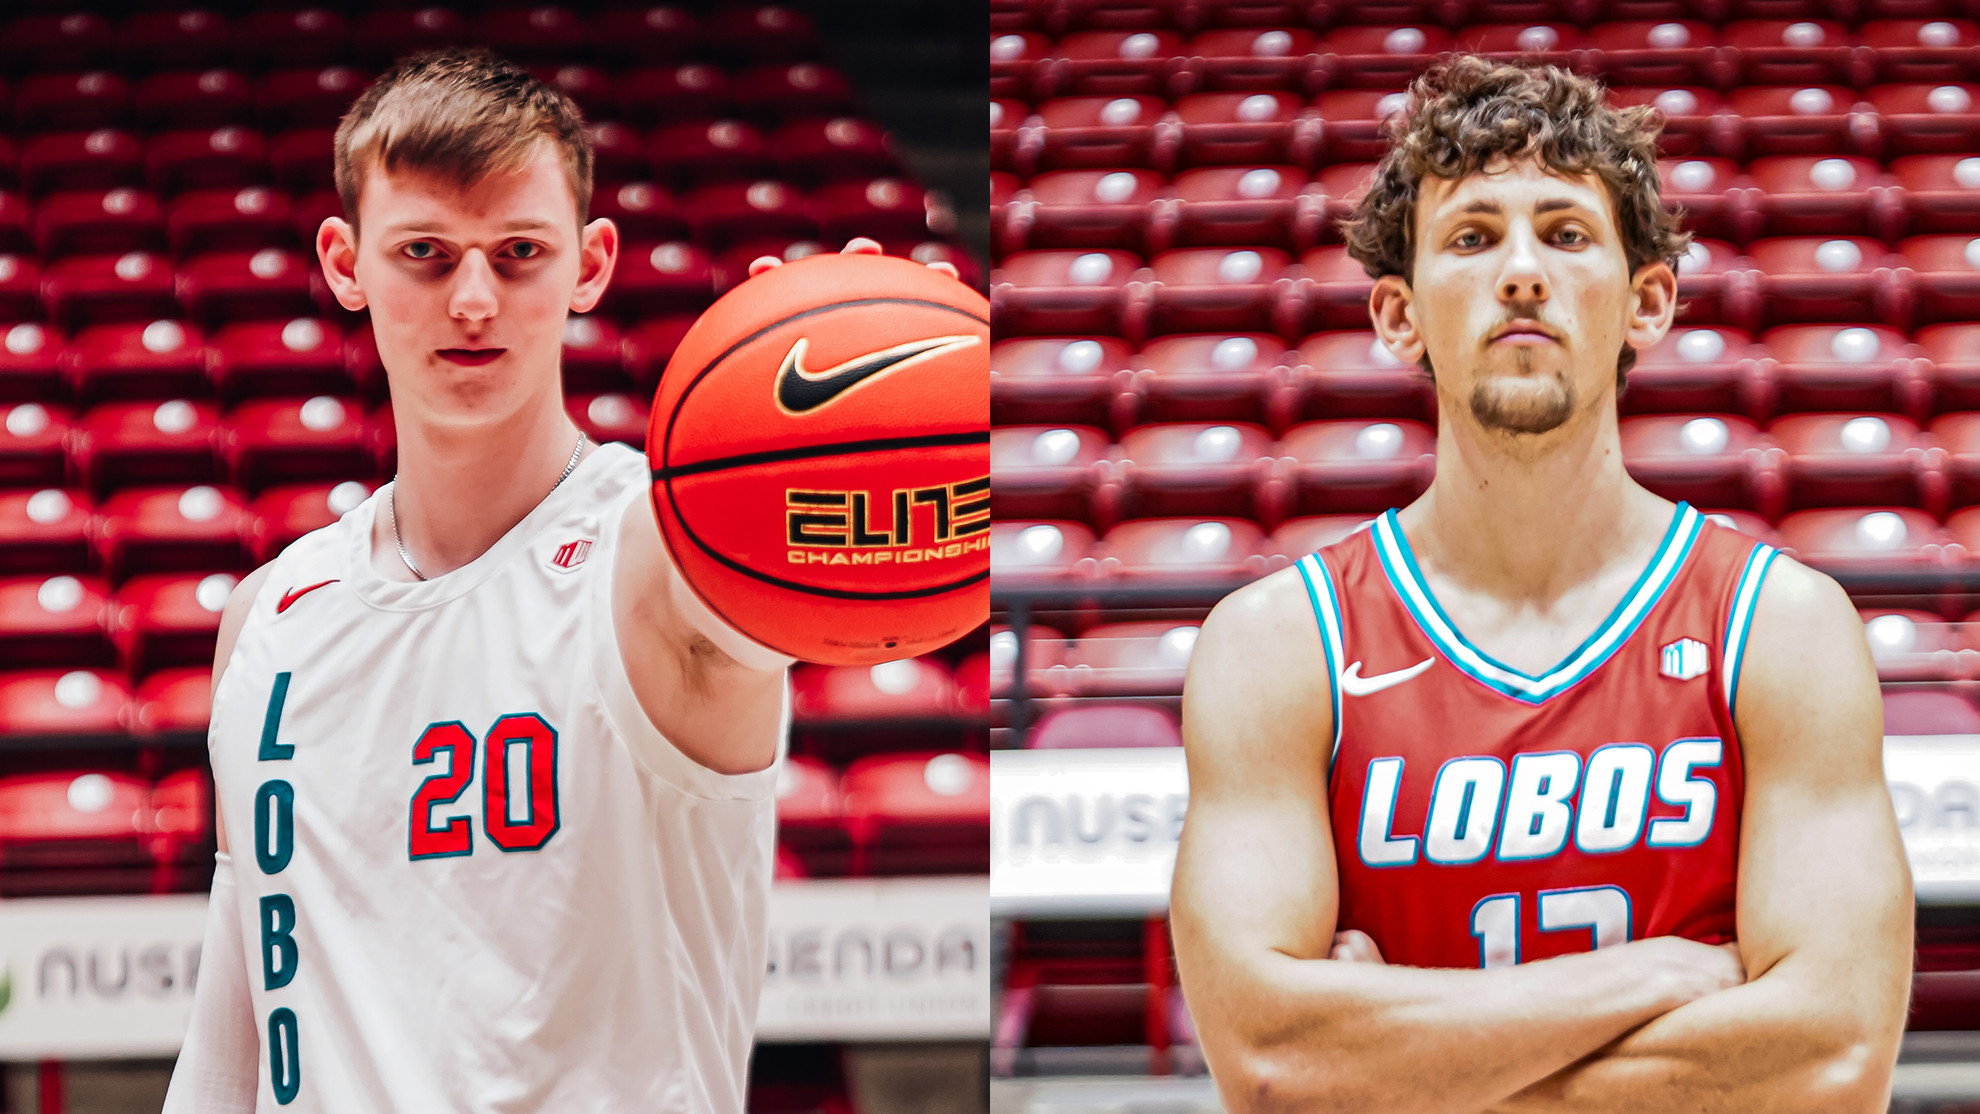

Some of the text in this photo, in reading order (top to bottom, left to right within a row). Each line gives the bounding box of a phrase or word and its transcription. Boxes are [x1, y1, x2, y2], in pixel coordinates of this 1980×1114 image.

[786, 474, 990, 548] ELITE
[409, 712, 561, 862] 20
[1357, 736, 1723, 868] LOBOS
